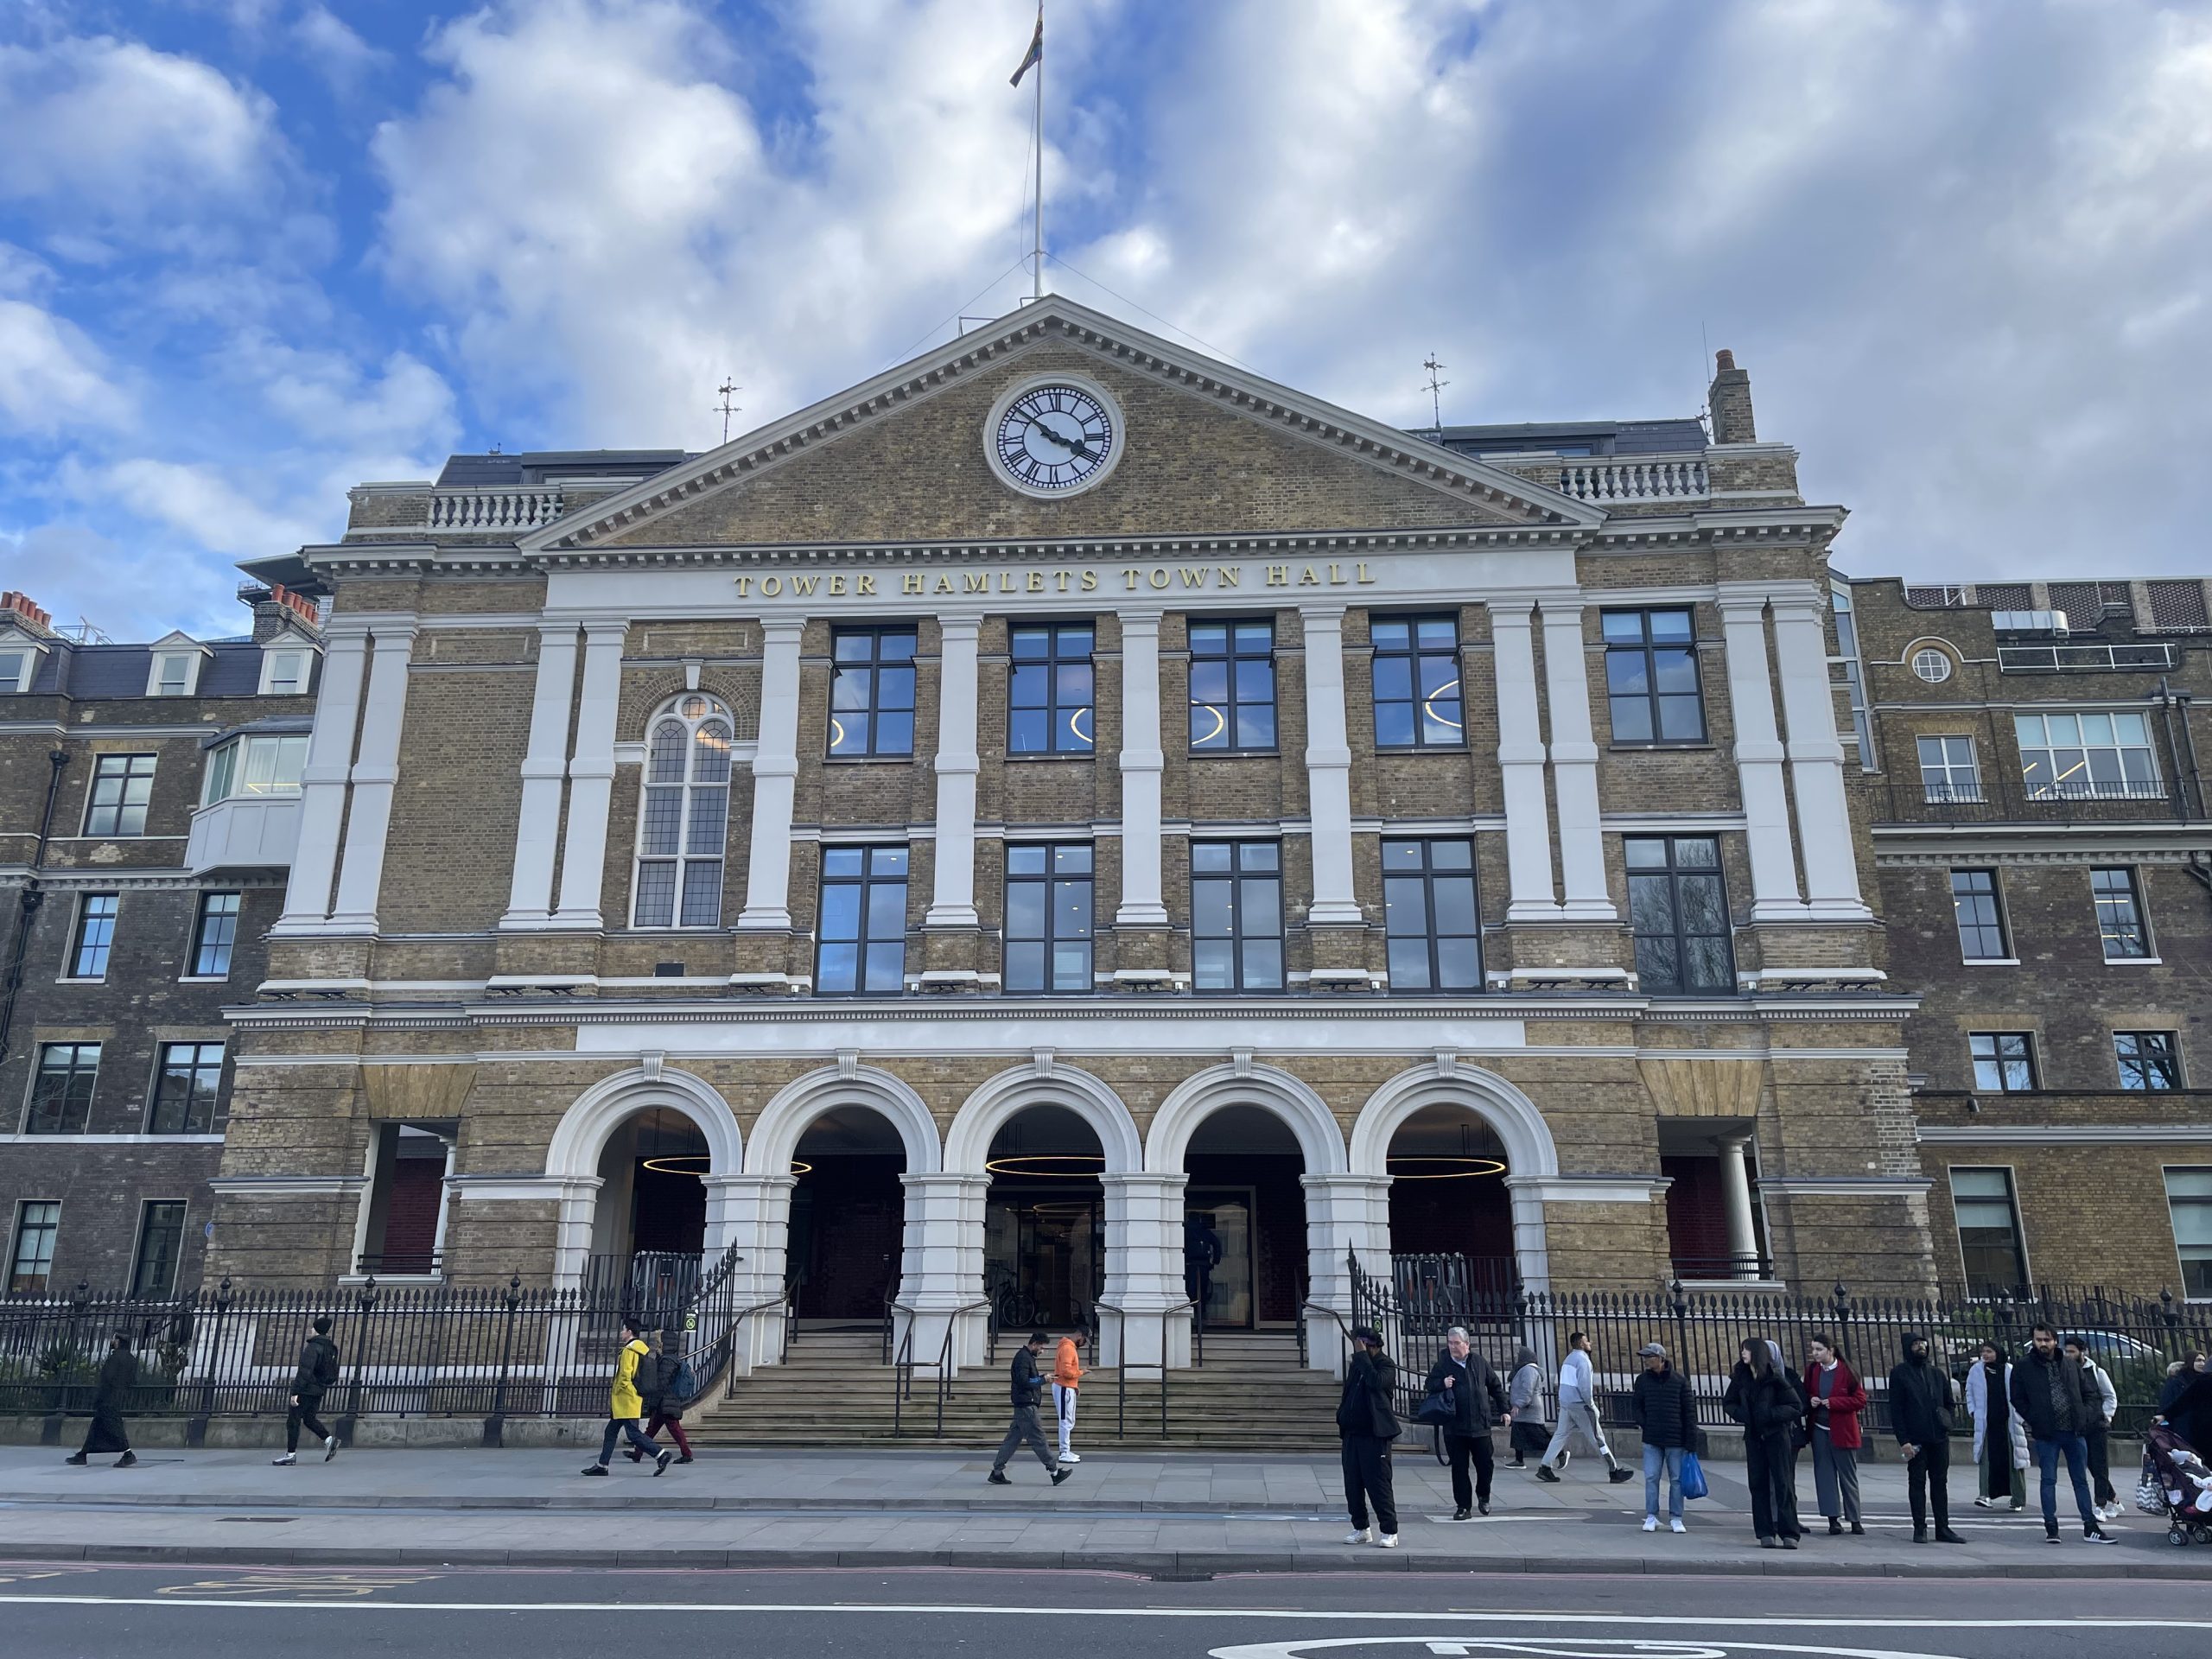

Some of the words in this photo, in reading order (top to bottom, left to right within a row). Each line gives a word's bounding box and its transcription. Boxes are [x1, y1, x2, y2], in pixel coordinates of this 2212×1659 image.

[1048, 394, 1061, 412] XII
[1069, 397, 1080, 416] I
[1080, 411, 1099, 426] II
[1084, 433, 1104, 442] III
[1007, 448, 1030, 467] VIII
[1025, 460, 1042, 480] VII
[1049, 464, 1059, 484] VI
[1069, 461, 1084, 478] V
[734, 575, 877, 597] TOWER
[901, 569, 1098, 594] HAMLETS
[1122, 566, 1241, 589] TOWN
[1265, 562, 1376, 586] HALL
